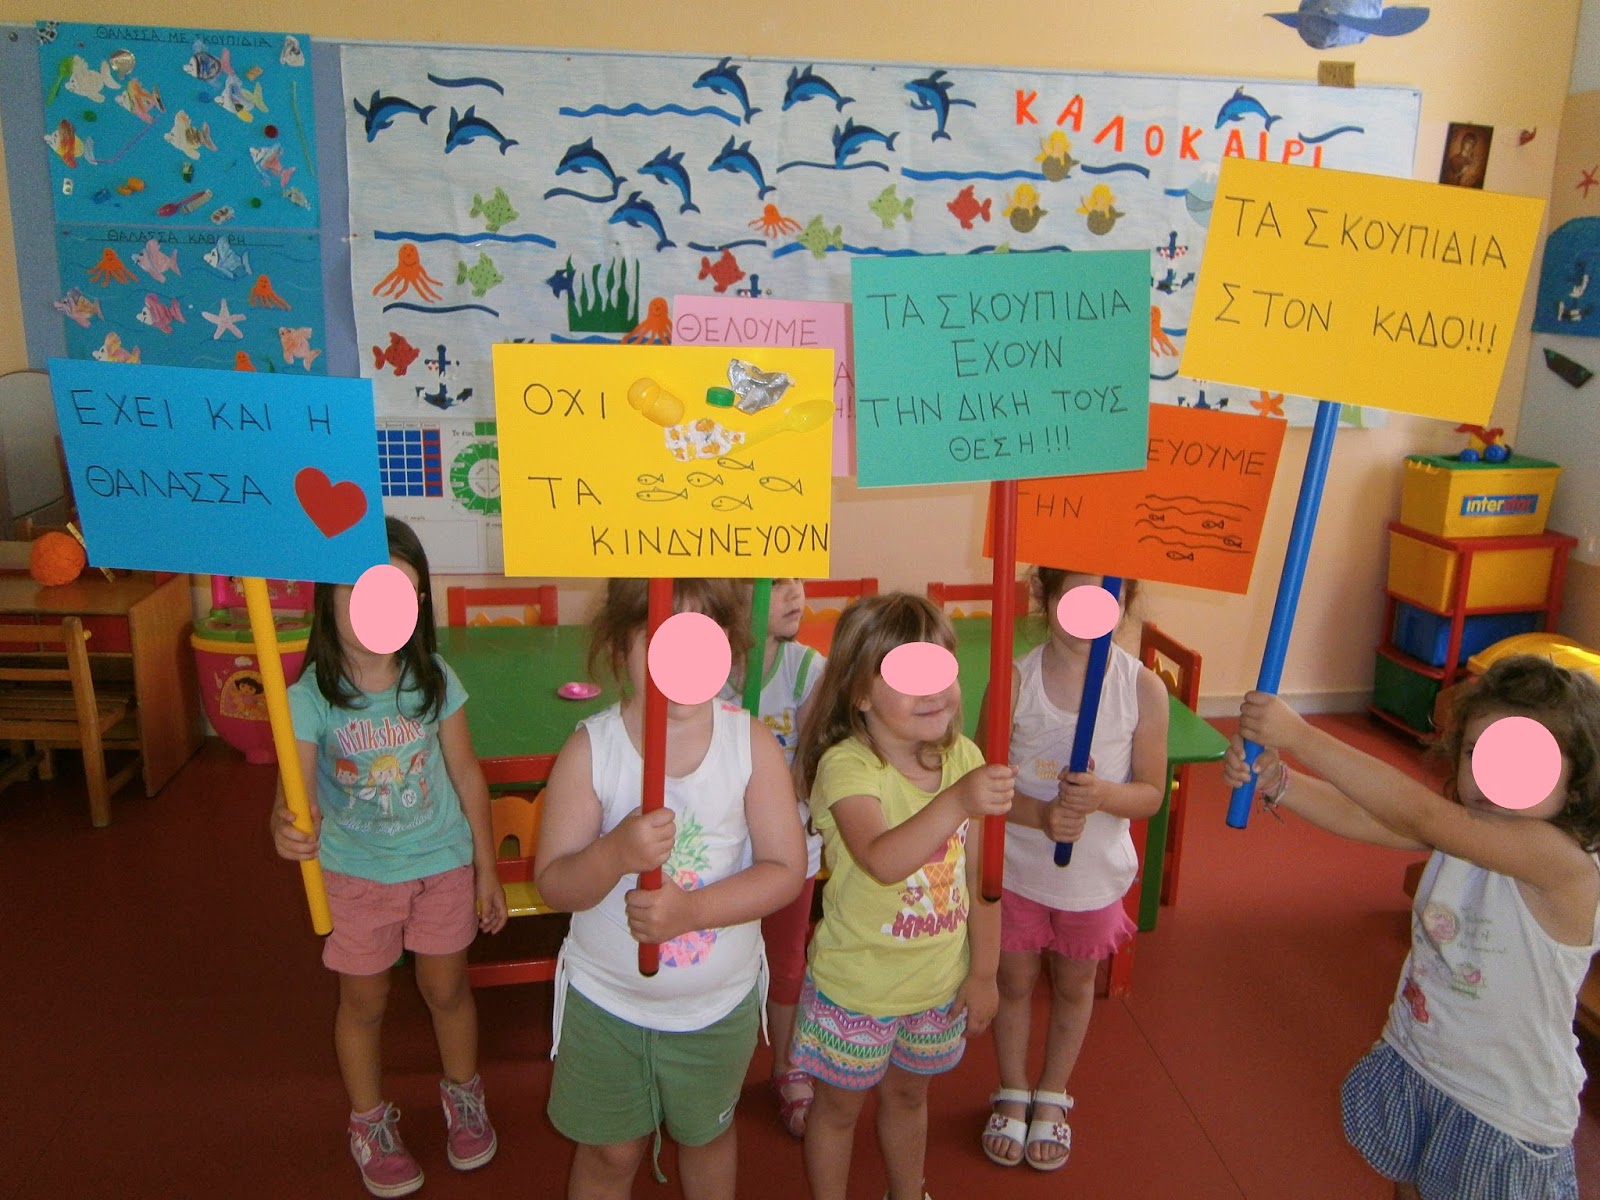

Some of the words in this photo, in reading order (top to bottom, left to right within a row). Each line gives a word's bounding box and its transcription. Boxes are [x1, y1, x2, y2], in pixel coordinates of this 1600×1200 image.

[97, 26, 161, 42] ΘΑΛΑΣΣΑ
[168, 32, 187, 43] ΜΕ
[1015, 89, 1323, 169] ΚΑΛΟΚΑΙΡΙ
[1225, 195, 1282, 238] ΤΑ
[1304, 207, 1507, 270] ΣΚΟΥΠΙΔΙΑ
[866, 293, 925, 330] ΤΑ
[936, 288, 1132, 329] ΣΚΟΥΠΙΔΙΑ
[1215, 282, 1333, 332] ΣΤΟΝ
[1373, 305, 1498, 354] ΚΑΔΟ!!!
[676, 313, 818, 347] ΘΕΛΟΥΜΕ
[951, 335, 1063, 378] ΕΧΟΥΝ
[70, 389, 173, 430] ΕΧΕΙ
[205, 397, 272, 432] ΚΑΙ
[307, 404, 331, 435] Η
[523, 382, 606, 419] ΟΧΙ
[859, 392, 942, 428] ΤΗΝ
[958, 389, 1031, 422] ΔΙΚΗ
[1051, 385, 1128, 414] ΤΟΥΣ
[1147, 438, 1267, 475] ΕΥΟΥΜΕ
[85, 465, 272, 505] ΘΑΛΑΣΣΑ
[527, 475, 602, 509] ΤΑ
[1018, 492, 1083, 518] ΗΝ
[591, 522, 828, 557] ΚΙΝΔΥΝΕΥΟΥΝ
[334, 714, 425, 757] Milkshake
